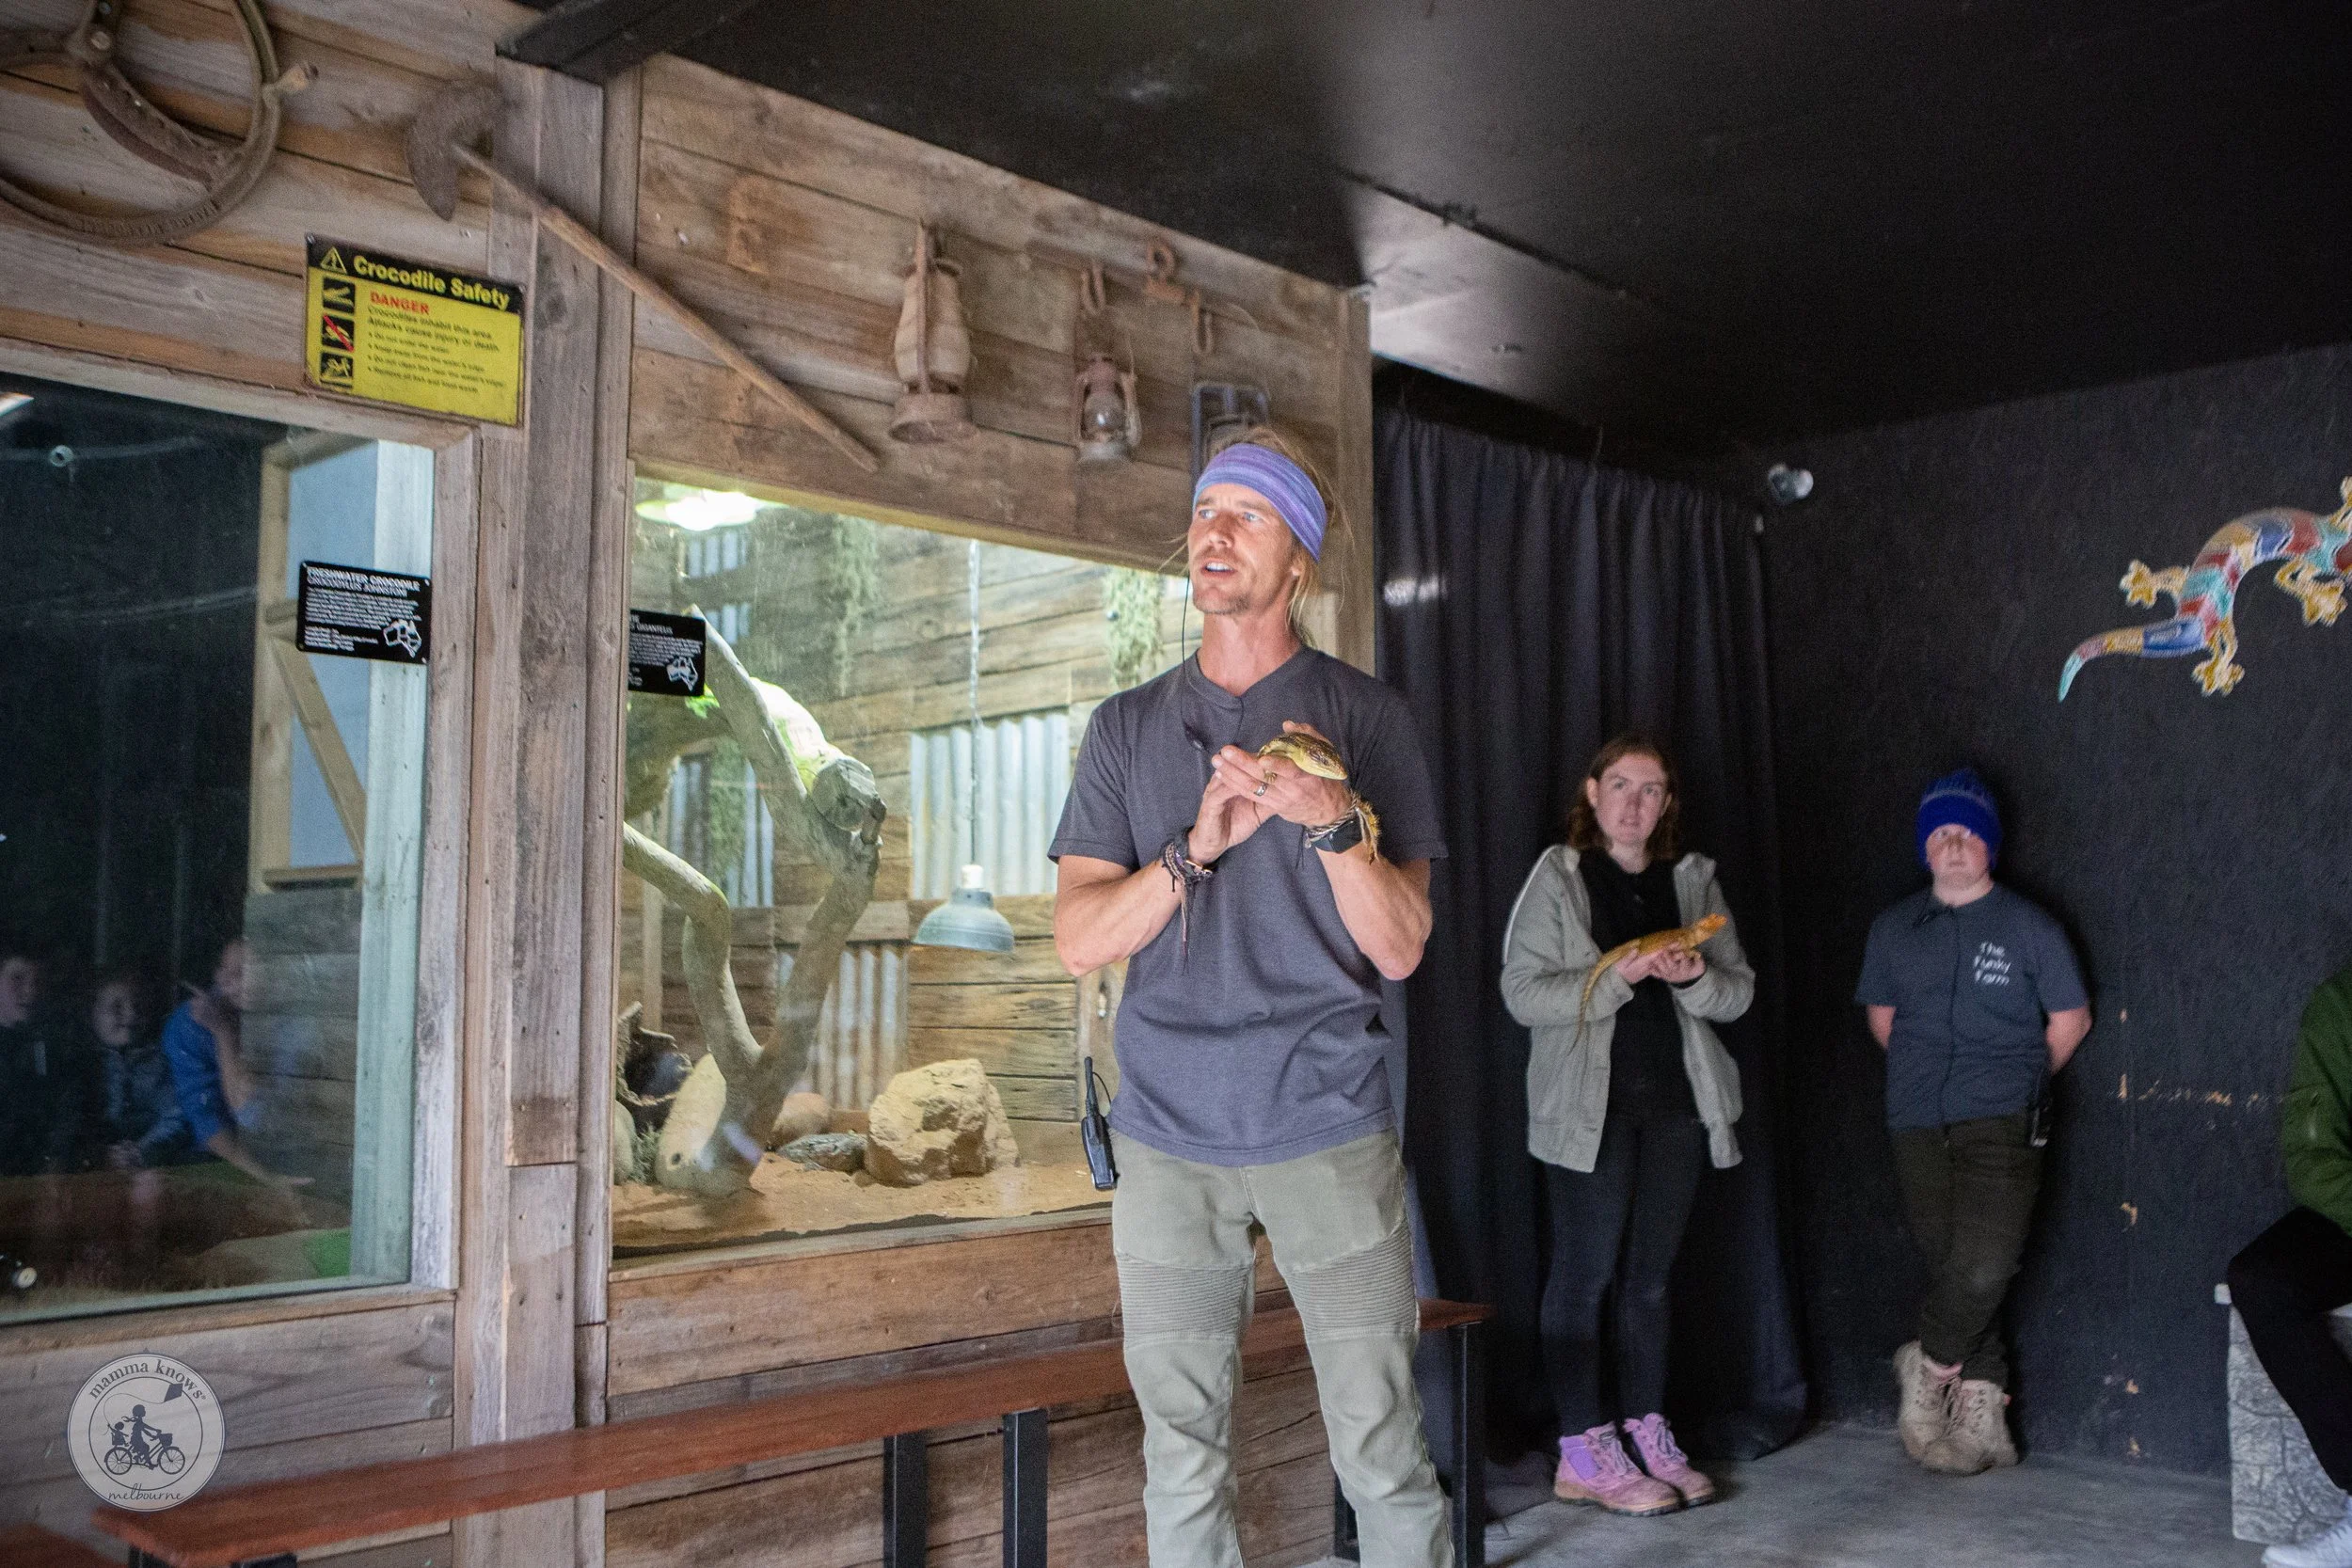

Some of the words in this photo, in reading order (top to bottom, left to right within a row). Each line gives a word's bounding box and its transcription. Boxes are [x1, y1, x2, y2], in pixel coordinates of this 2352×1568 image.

[353, 255, 447, 293] Crocodile
[451, 277, 511, 311] Safety
[370, 290, 430, 314] DANGER
[368, 306, 417, 323] Crocodiles
[420, 317, 452, 330] inhabit
[453, 323, 470, 335] this
[368, 316, 402, 331] Attacks
[405, 326, 431, 338] cause
[435, 331, 460, 346] injury
[1979, 942, 2005, 958] The
[1973, 955, 2012, 974] Funky
[1975, 969, 2010, 987] Farm
